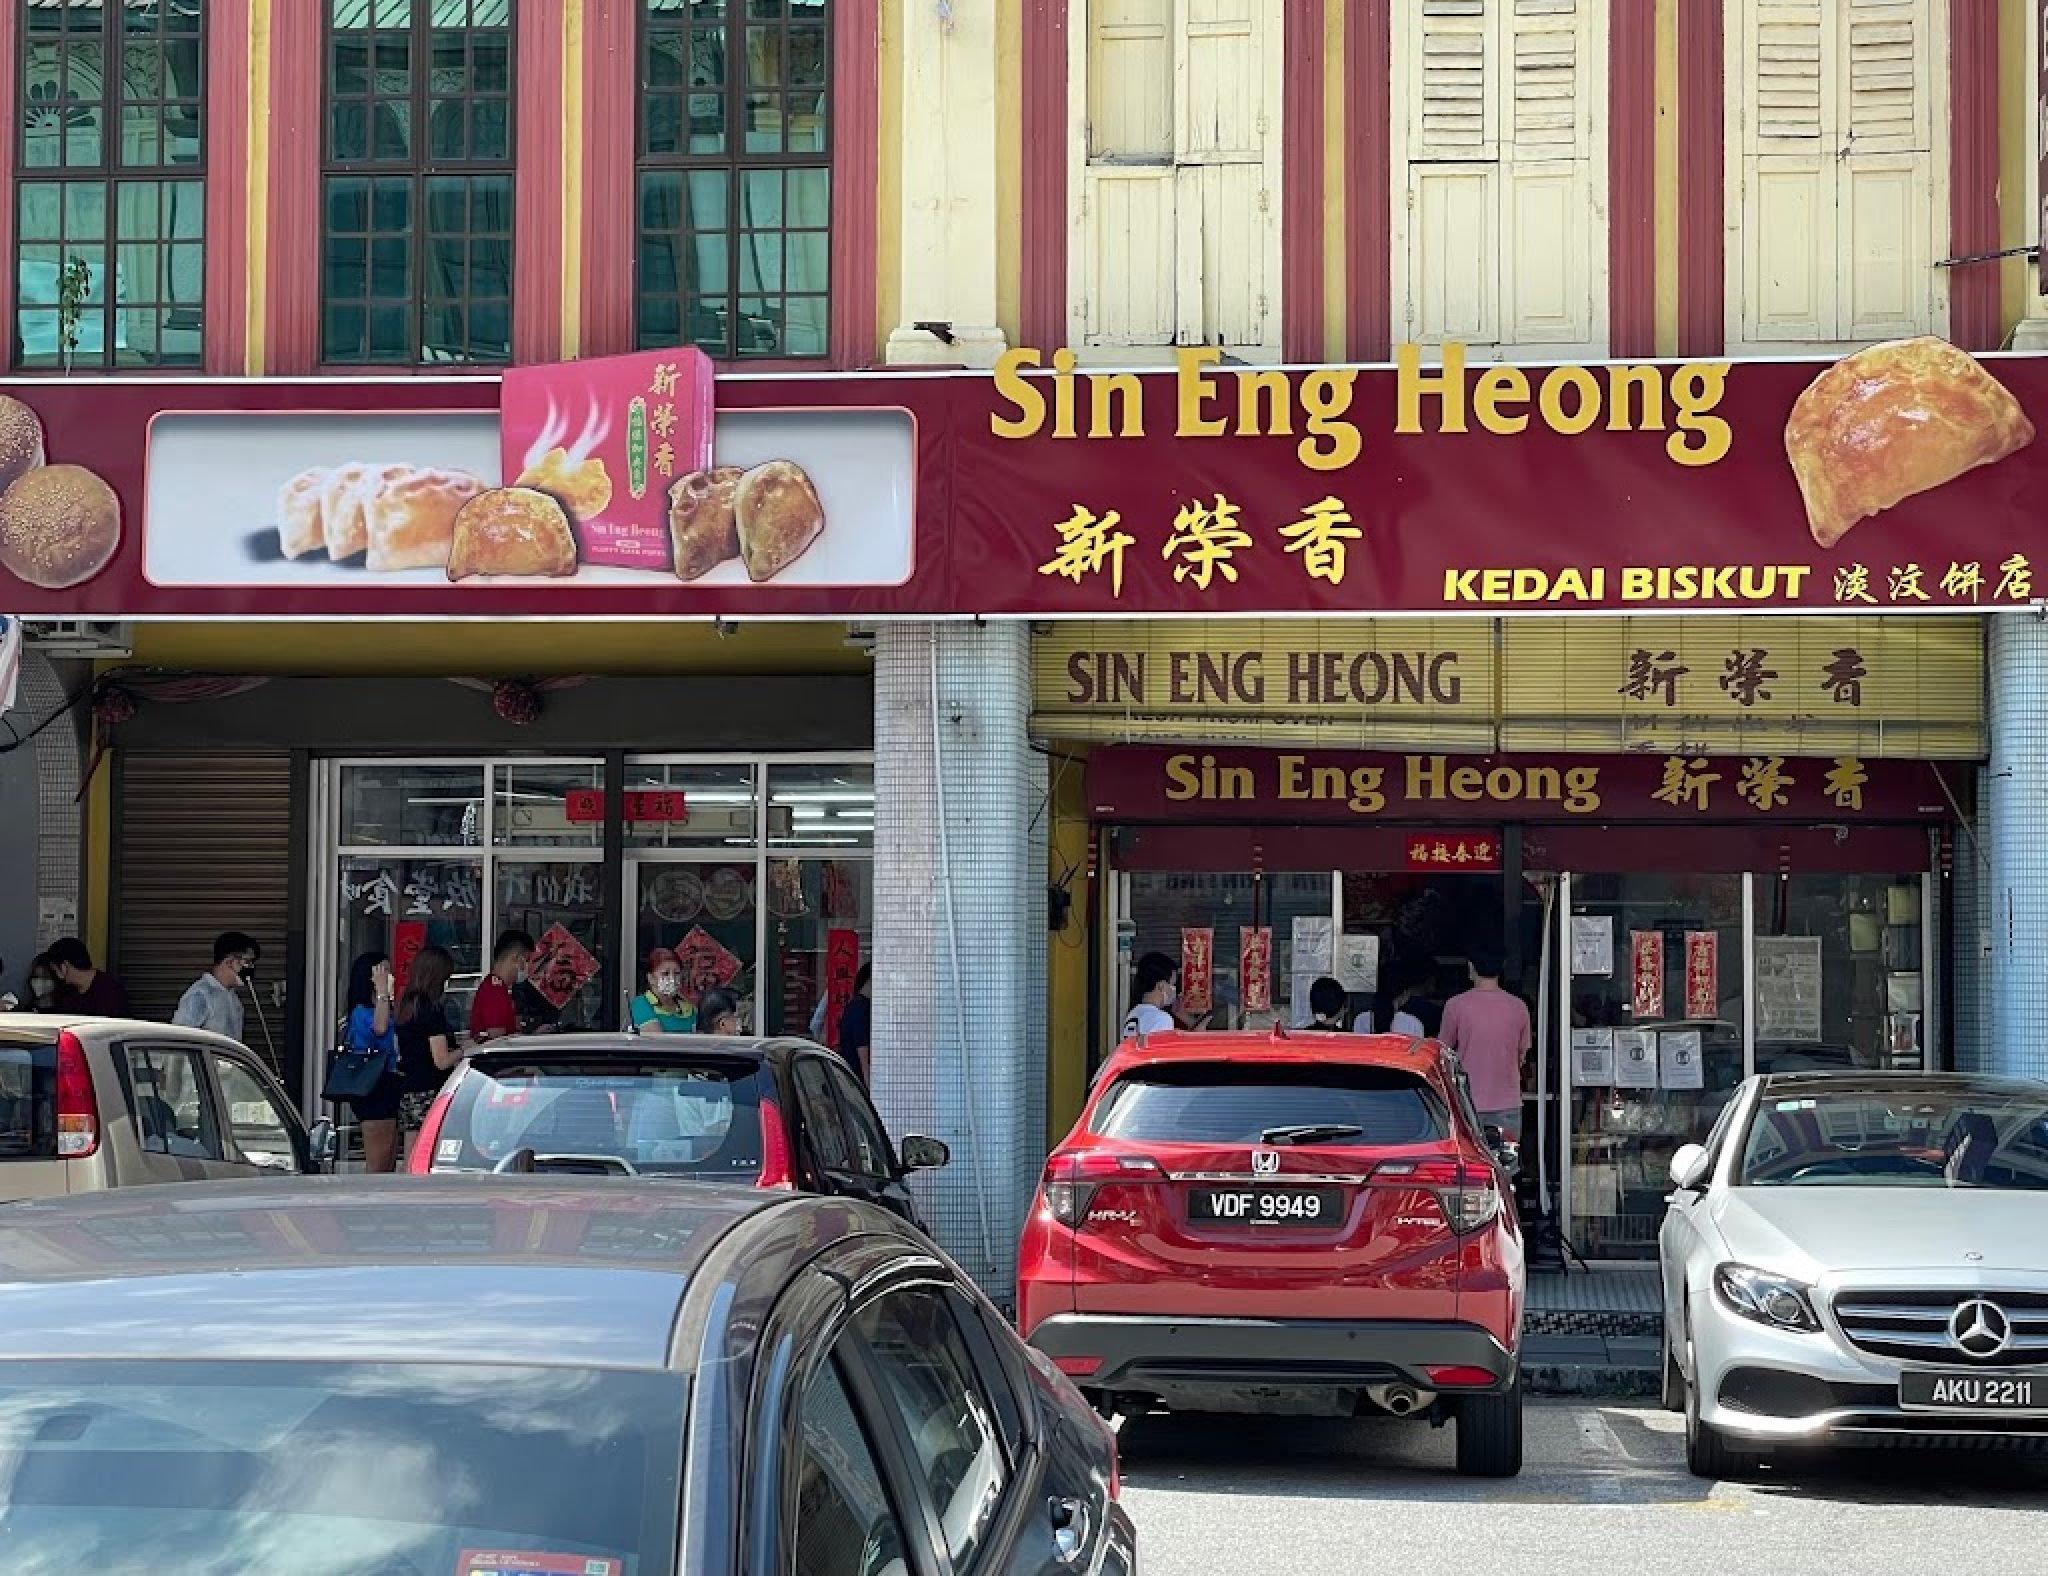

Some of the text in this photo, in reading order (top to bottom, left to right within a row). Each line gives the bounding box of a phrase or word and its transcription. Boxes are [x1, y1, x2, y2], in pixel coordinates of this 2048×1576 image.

[649, 363, 682, 477] 新榮香
[991, 341, 1733, 471] Sin Eng Heong
[1038, 493, 1363, 599] 新榮香
[1443, 565, 1811, 602] KEDAI BISKUT
[1066, 650, 1462, 706] SIN ENG HEONG
[1617, 647, 1868, 707] 新榮香
[1164, 753, 1602, 814] Sin Eng Heong
[1650, 756, 1869, 812] 新榮香
[1211, 1193, 1322, 1219] VDF 9949
[1931, 1379, 2032, 1405] AKU 2211
